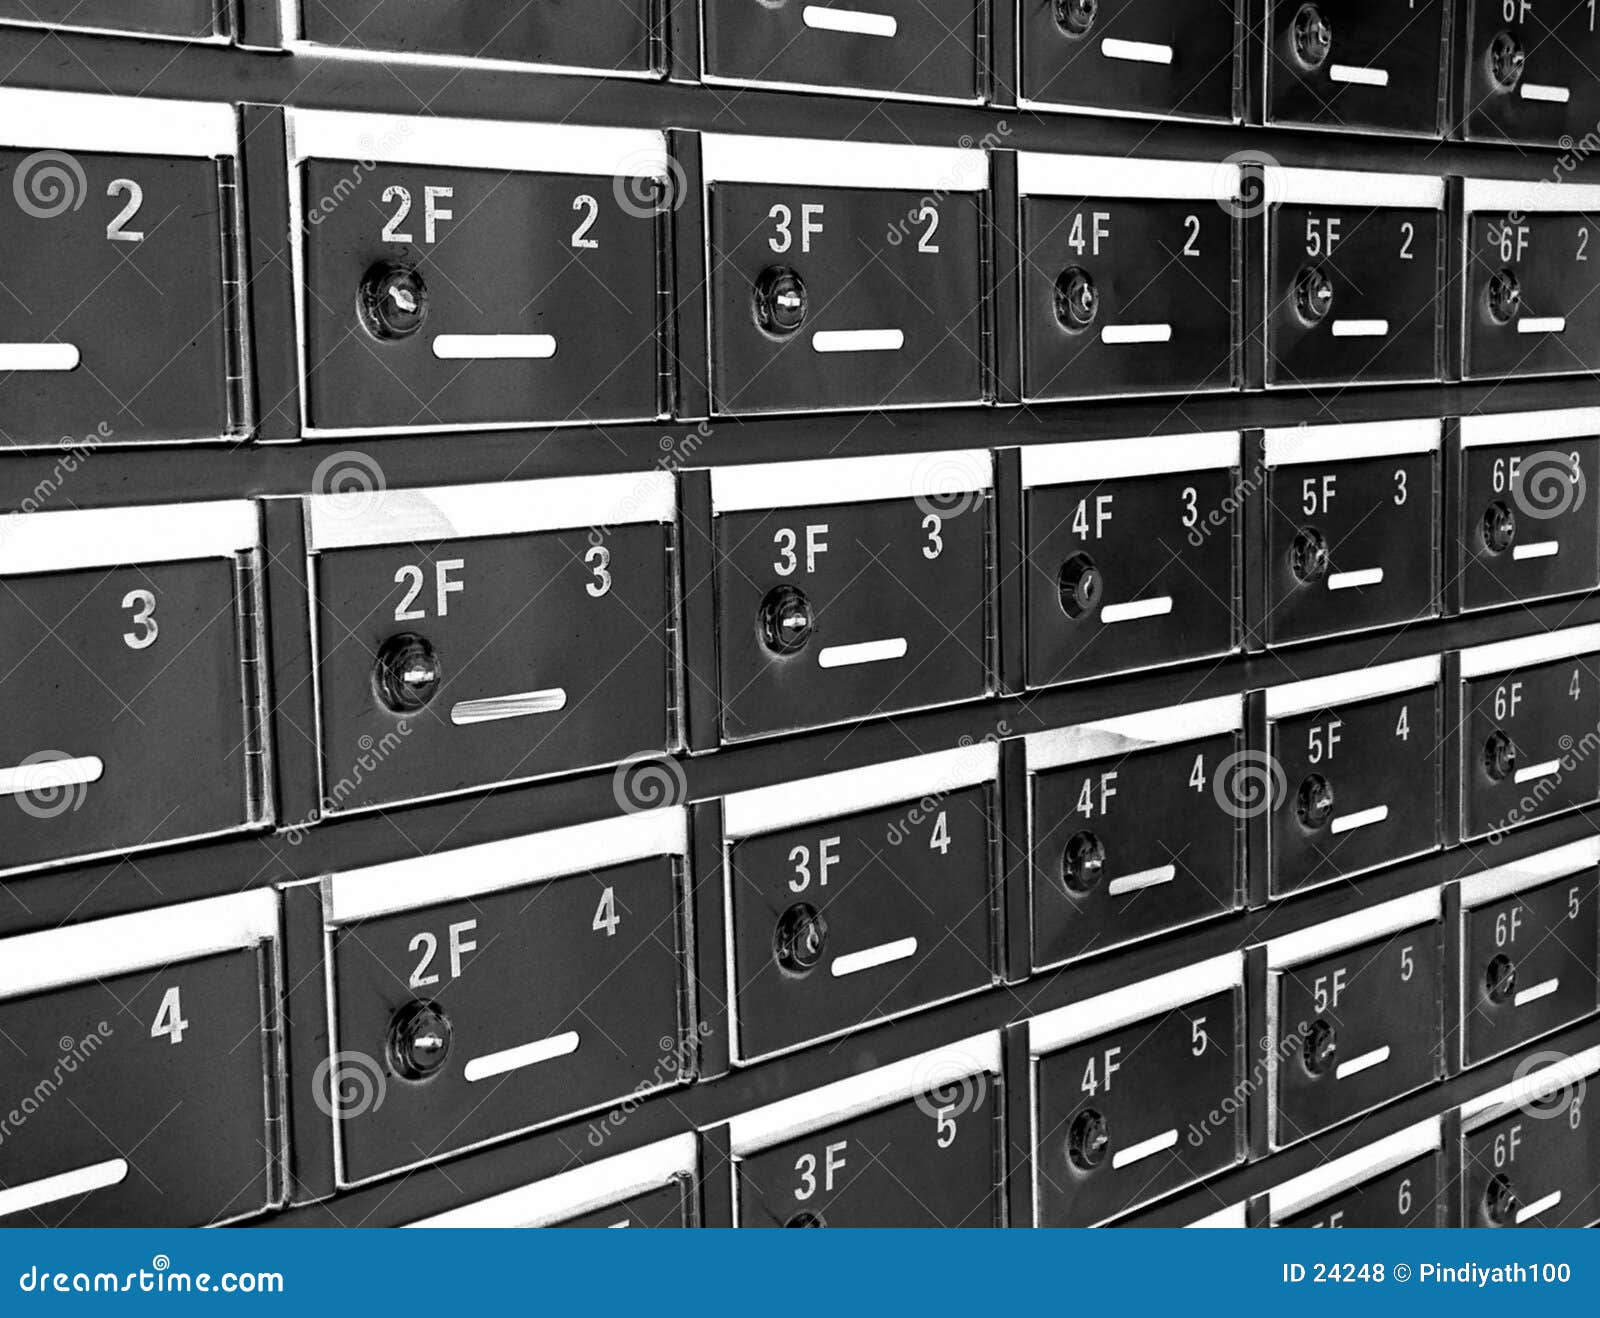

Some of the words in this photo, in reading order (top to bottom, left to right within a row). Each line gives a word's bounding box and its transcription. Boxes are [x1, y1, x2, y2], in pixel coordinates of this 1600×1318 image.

[106, 178, 144, 242] 2
[381, 185, 454, 244] 2F
[571, 194, 599, 249] 2
[768, 203, 824, 253] 3F
[918, 206, 939, 253] 2
[1068, 212, 1110, 256] 4F
[1183, 215, 1200, 257] 2
[1306, 218, 1341, 257] 5F
[1400, 222, 1414, 259] 2
[1500, 226, 1529, 262] 6F
[1576, 227, 1588, 260] 2
[1303, 475, 1336, 515] 5F
[1394, 470, 1407, 505] 3
[1493, 456, 1521, 493] 6F
[1568, 451, 1581, 484] 3
[1072, 495, 1113, 540] 4F
[1182, 487, 1198, 527] 3
[773, 524, 829, 576] 3F
[921, 513, 943, 559] 3
[394, 558, 465, 621] 2F
[584, 545, 612, 598] 3
[121, 589, 159, 650] 3
[1495, 682, 1522, 721] 6F
[1567, 668, 1581, 701] 4
[1308, 720, 1342, 764] 5F
[1396, 706, 1410, 741] 4
[1077, 771, 1118, 818] 4F
[1189, 754, 1206, 792] 4
[788, 836, 841, 893] 3F
[930, 811, 951, 855] 4
[408, 918, 477, 989] 2F
[592, 886, 620, 936] 4
[1495, 907, 1522, 947] 6F
[1569, 887, 1579, 919] 5
[1314, 968, 1346, 1014] 5F
[1401, 946, 1414, 981] 5
[151, 986, 189, 1044] 4
[1081, 1046, 1121, 1097] 4F
[1192, 1017, 1207, 1056] 5
[794, 1140, 847, 1201] 3F
[937, 1103, 957, 1148] 5
[1494, 1123, 1522, 1168] 6F
[1399, 1179, 1411, 1215] 6
